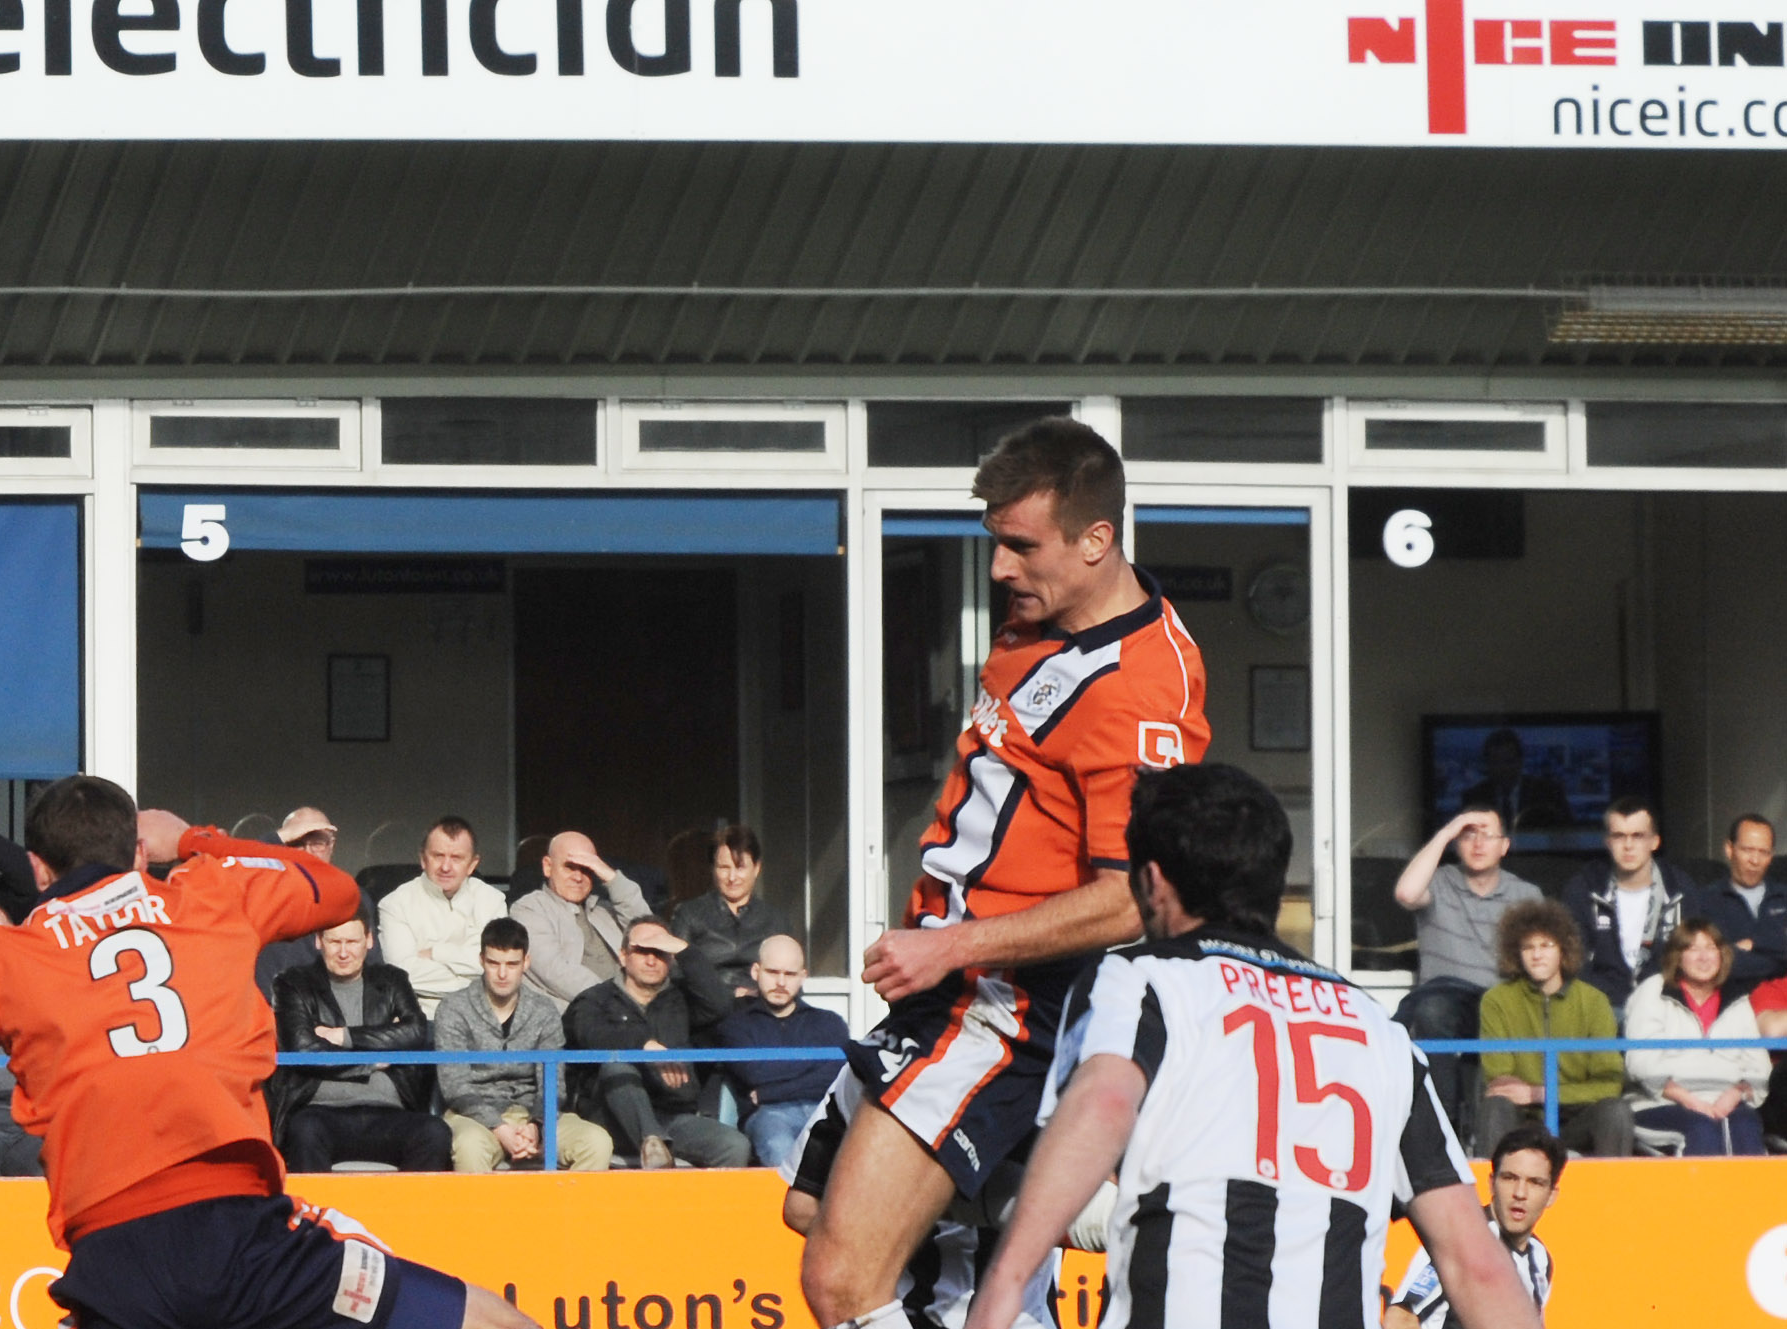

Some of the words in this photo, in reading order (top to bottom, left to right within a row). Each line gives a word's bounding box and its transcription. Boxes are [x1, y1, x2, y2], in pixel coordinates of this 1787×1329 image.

[1347, 0, 1616, 134] NICE
[180, 504, 230, 562] 5
[1382, 509, 1434, 568] 6
[43, 895, 172, 949] TAYLOR
[89, 928, 189, 1058] 3
[1220, 963, 1358, 1019] PREECE
[1223, 1004, 1372, 1192] 15
